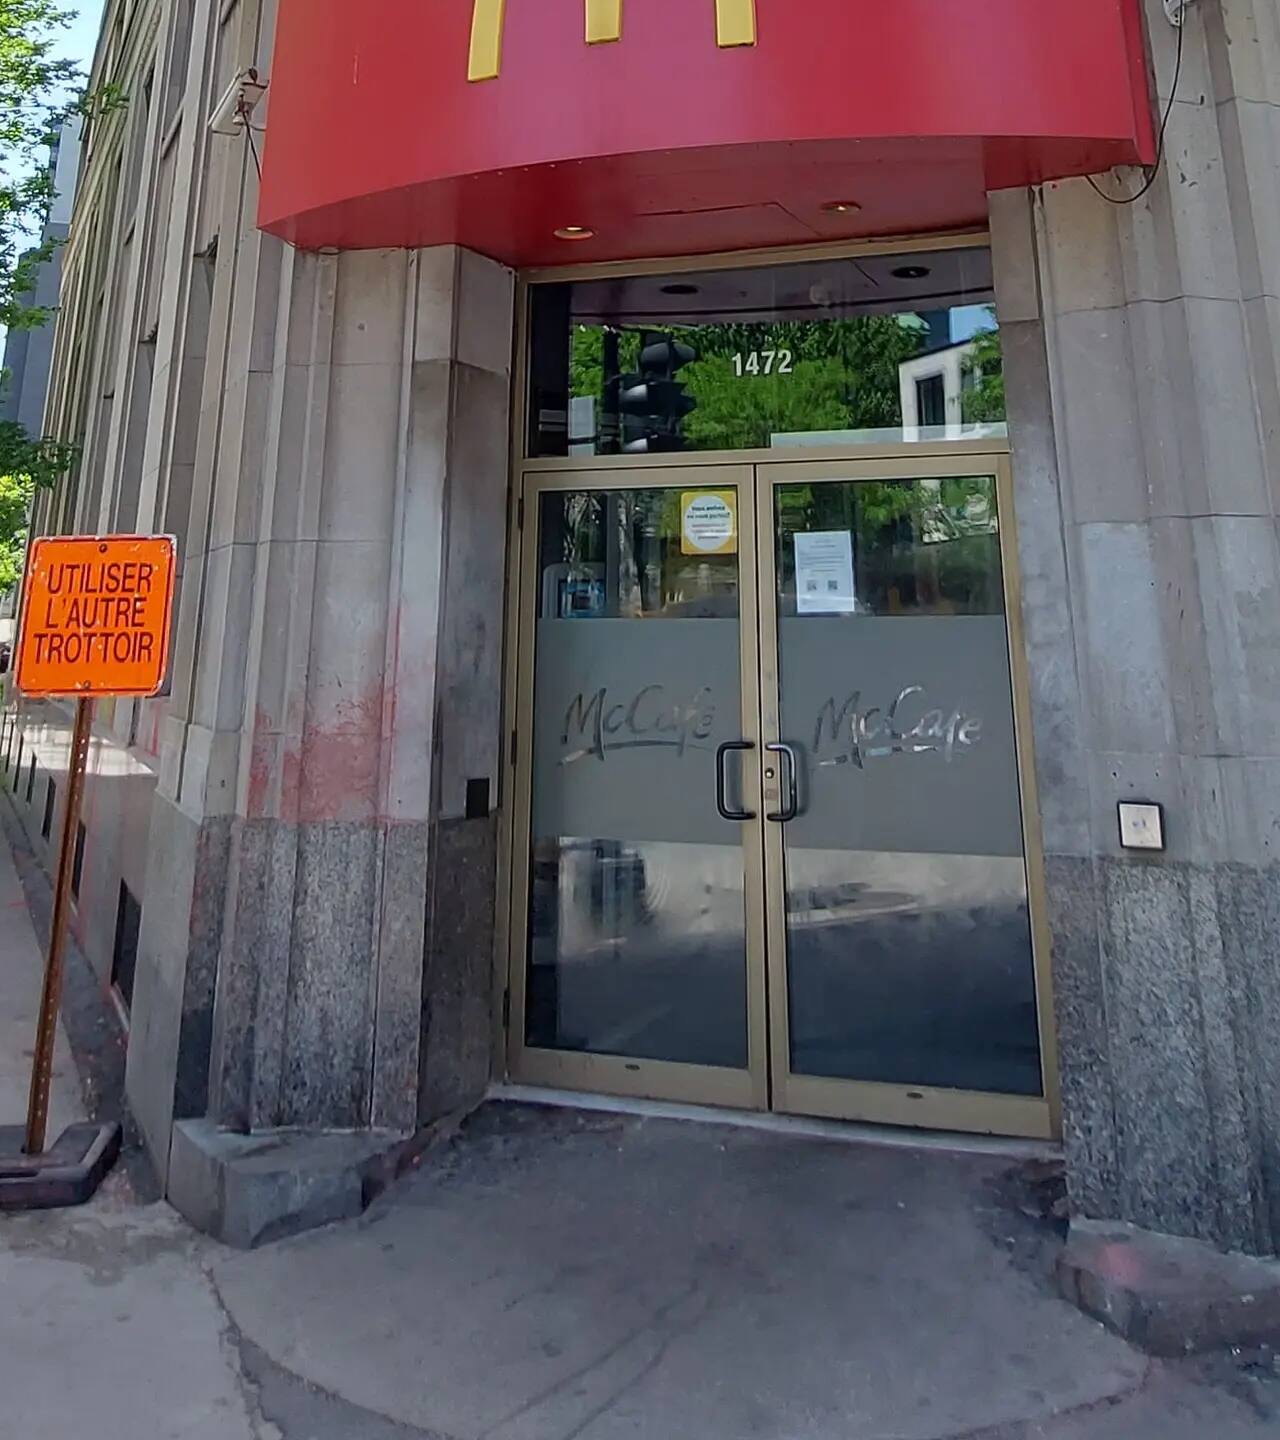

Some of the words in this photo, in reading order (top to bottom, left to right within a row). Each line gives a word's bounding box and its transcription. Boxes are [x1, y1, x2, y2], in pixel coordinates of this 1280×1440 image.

[731, 349, 792, 377] 1472
[47, 562, 153, 594] UTILISER
[45, 597, 147, 629] L'AUTRE
[33, 631, 154, 664] TROTTOIR
